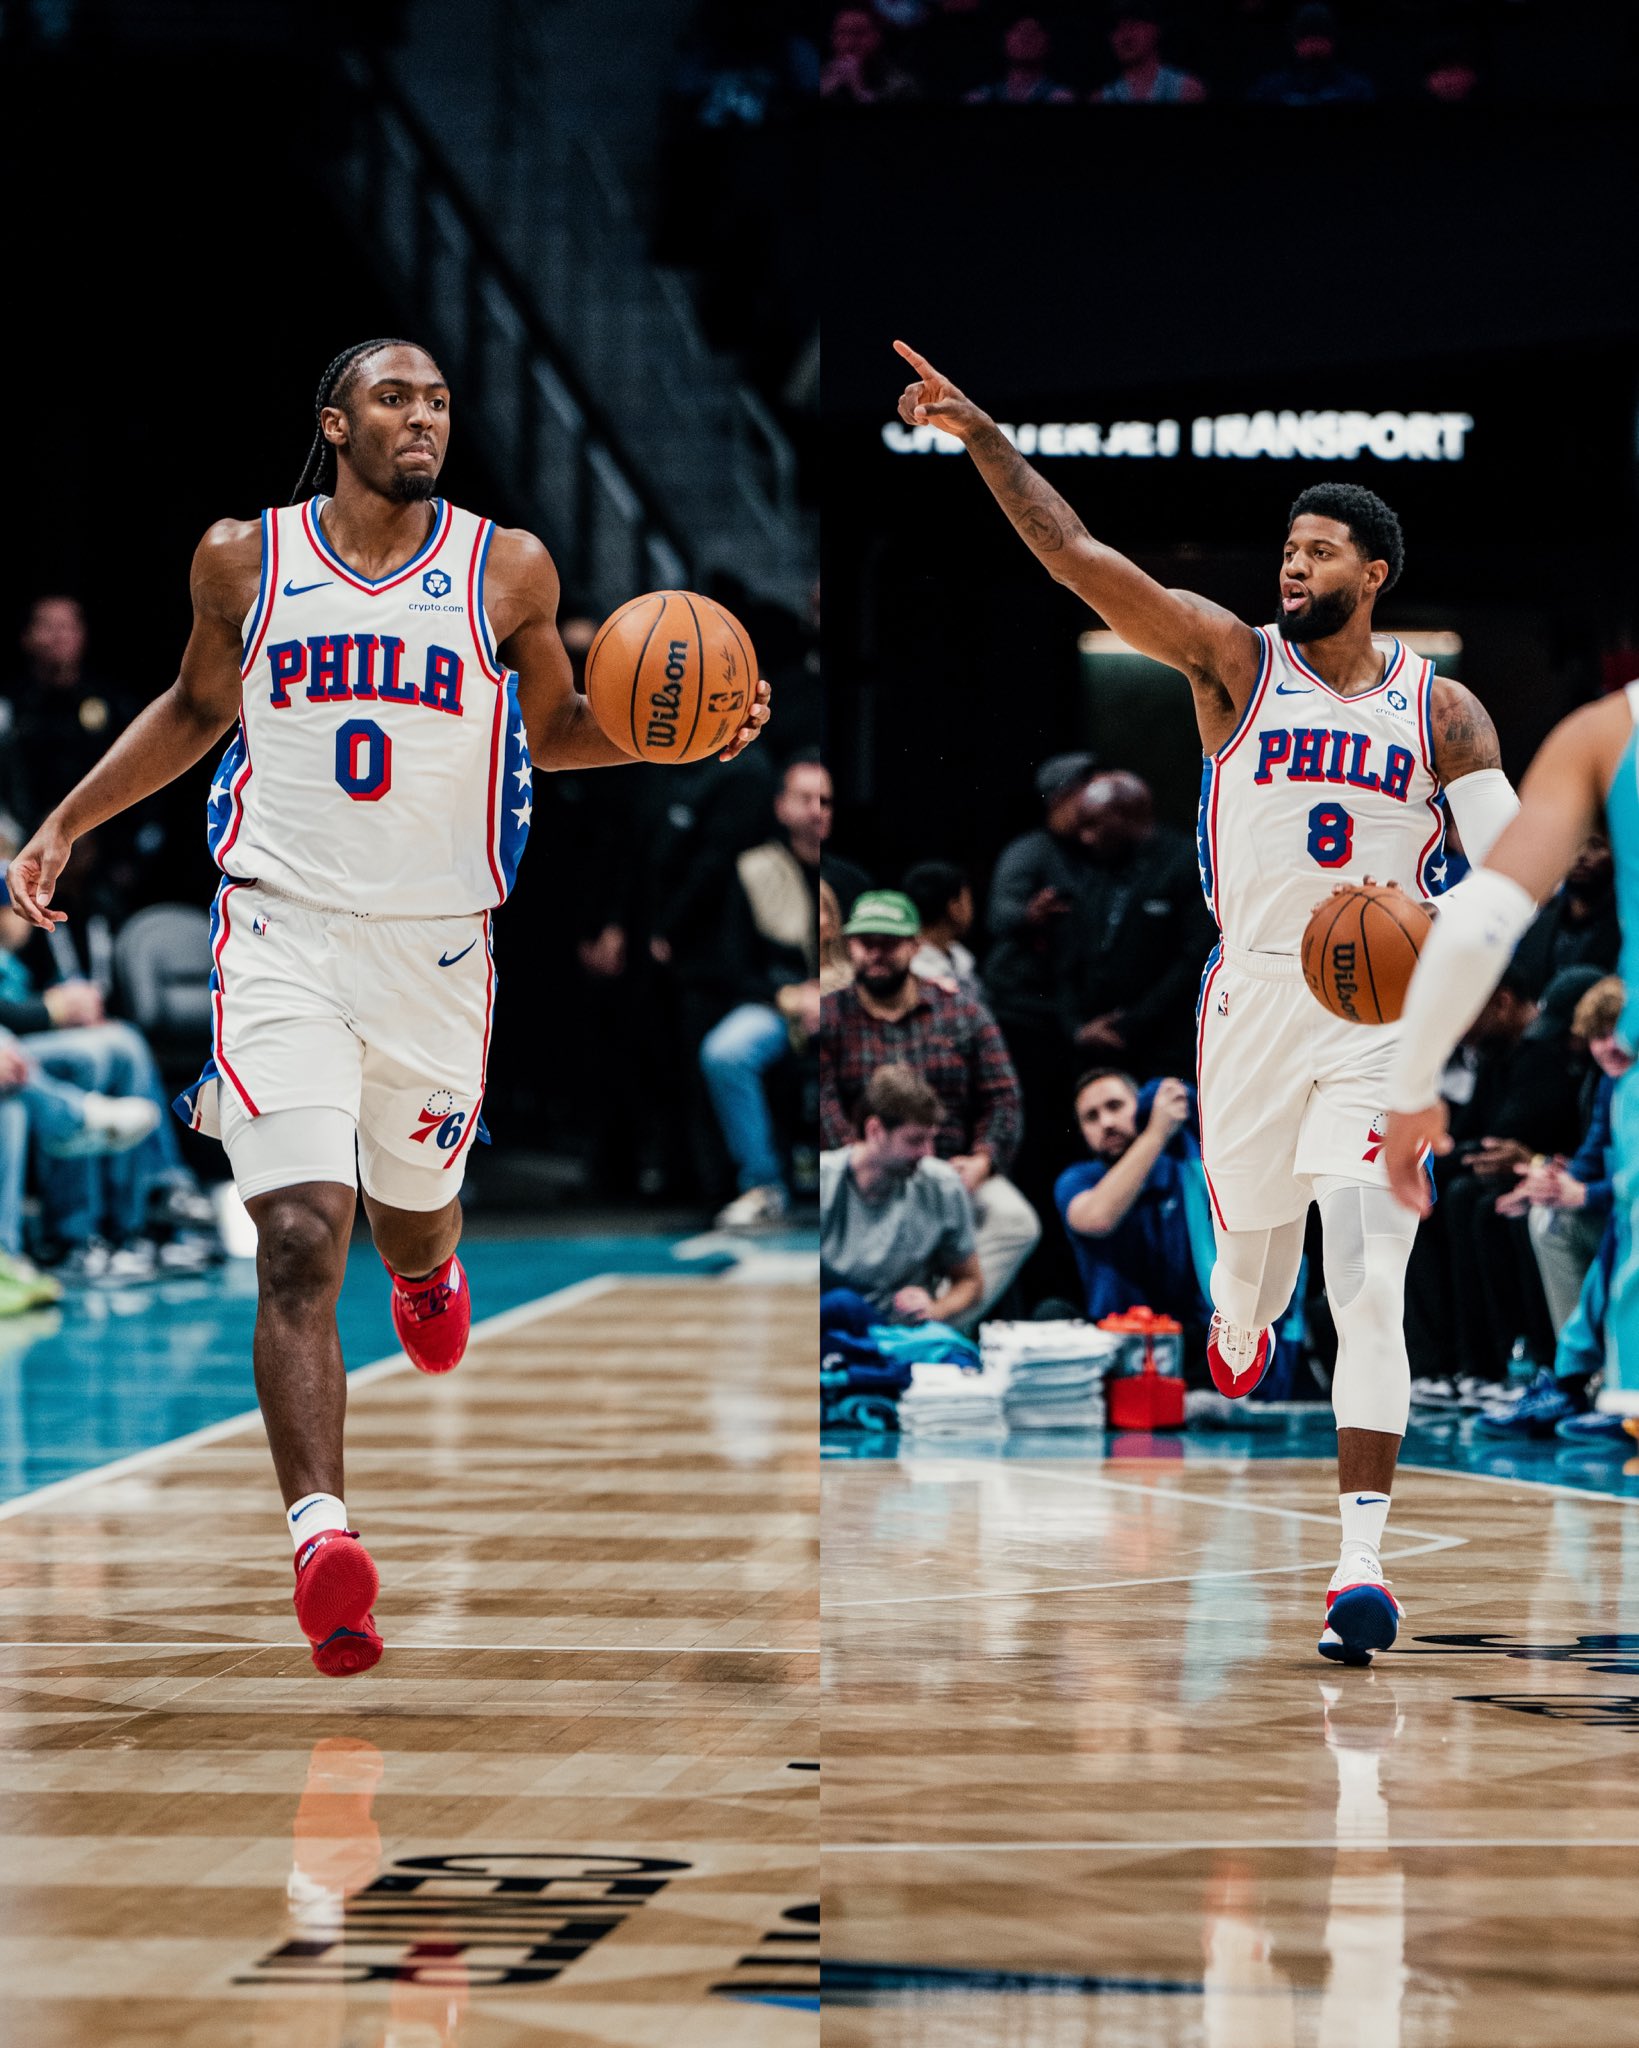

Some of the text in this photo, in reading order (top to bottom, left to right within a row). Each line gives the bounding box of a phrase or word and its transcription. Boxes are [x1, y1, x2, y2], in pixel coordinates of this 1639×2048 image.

[408, 602, 464, 613] crypto.com
[267, 633, 464, 717] PHILA
[646, 640, 688, 748] Wilson
[335, 718, 392, 802] 0
[1254, 728, 1416, 803] PHILA
[1307, 802, 1354, 868] 8
[408, 1106, 466, 1150] 76
